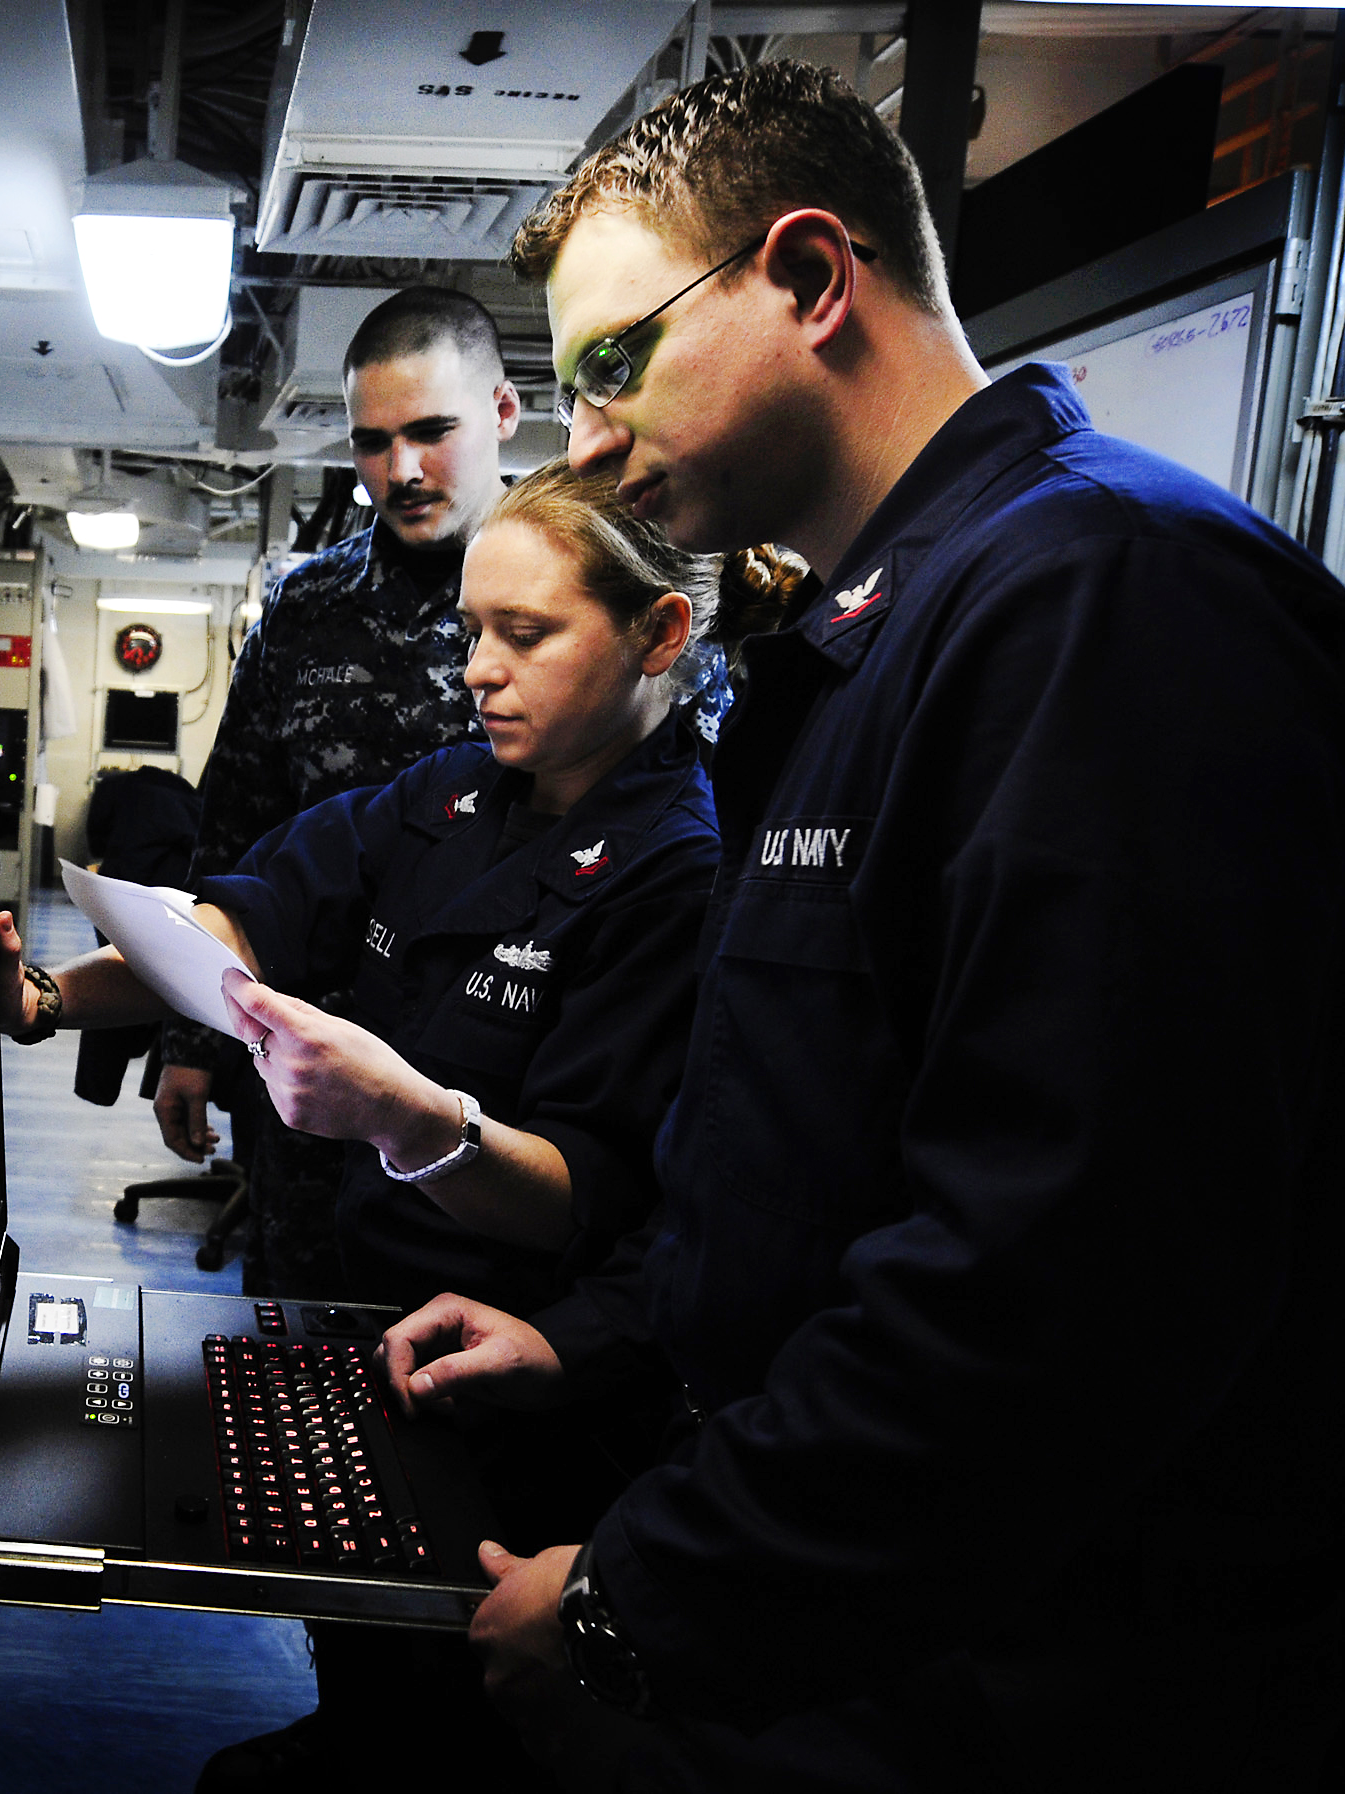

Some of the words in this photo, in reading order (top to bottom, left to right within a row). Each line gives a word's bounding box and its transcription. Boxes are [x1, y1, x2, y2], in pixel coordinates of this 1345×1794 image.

[297, 666, 353, 685] MCHALE
[791, 828, 851, 868] NAVY
[366, 918, 396, 958] SELL
[466, 971, 494, 1002] U.S.
[329, 1486, 341, 1494] D
[364, 1494, 376, 1502] X
[369, 1510, 382, 1518] Z
